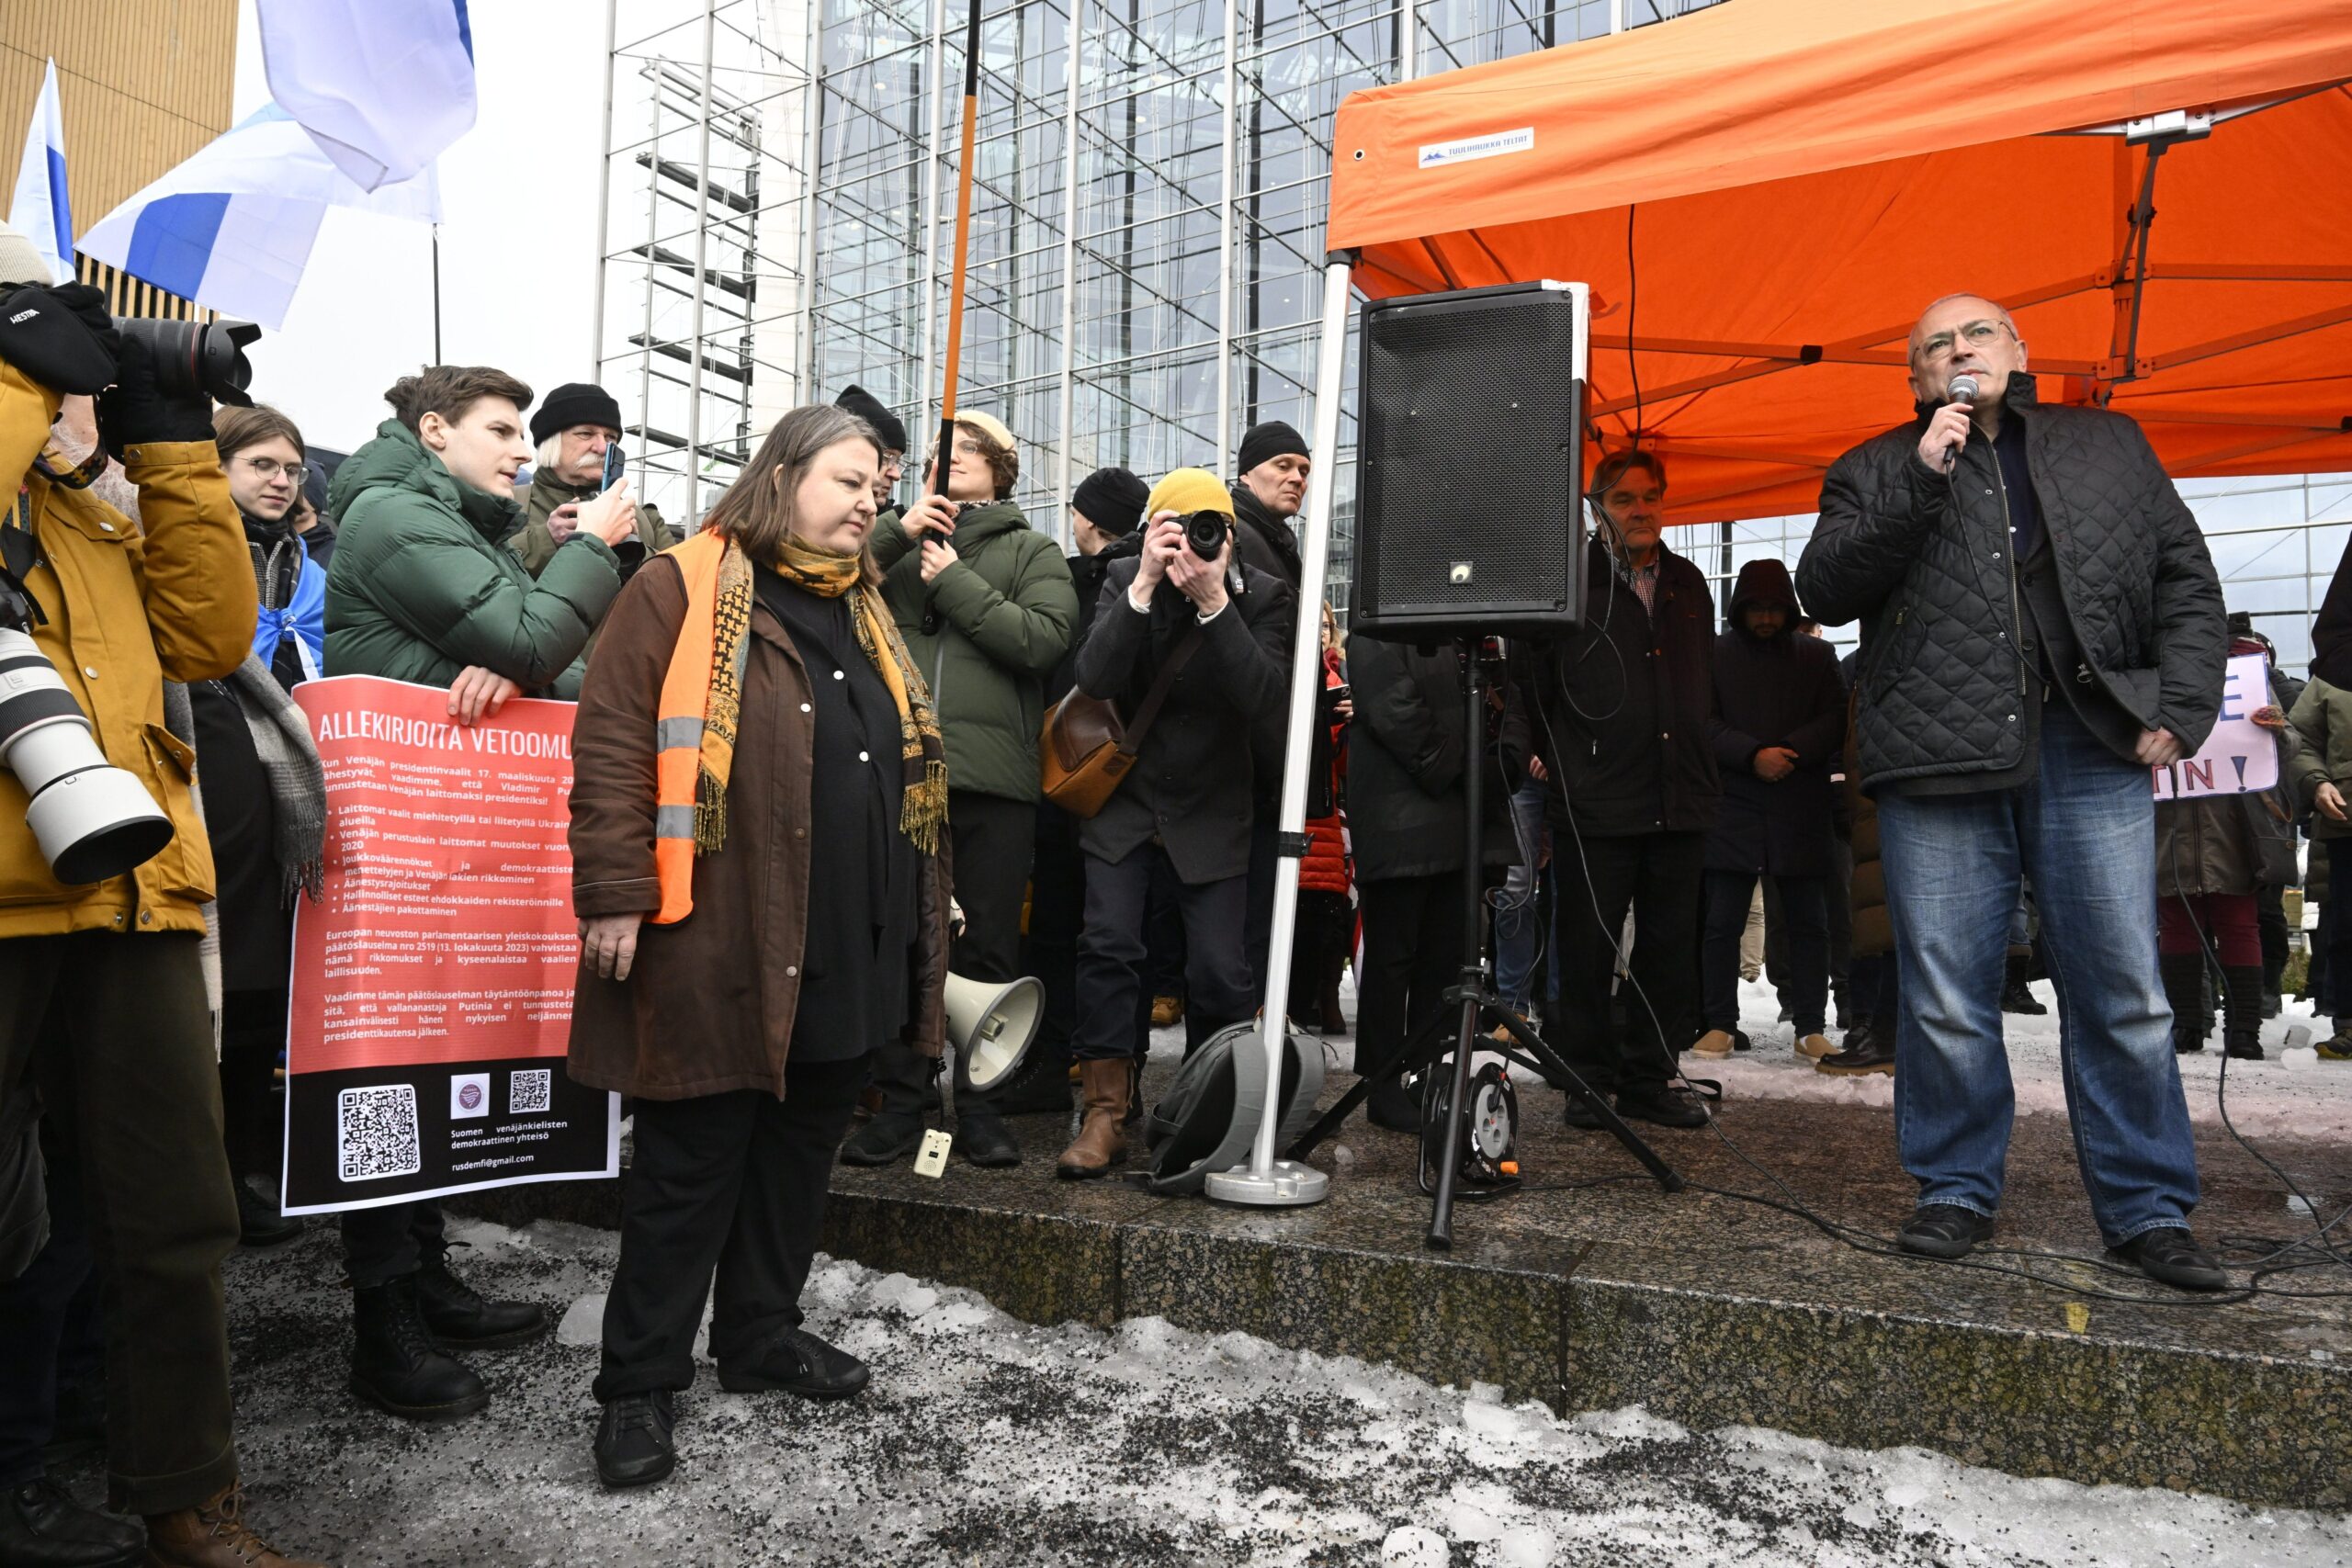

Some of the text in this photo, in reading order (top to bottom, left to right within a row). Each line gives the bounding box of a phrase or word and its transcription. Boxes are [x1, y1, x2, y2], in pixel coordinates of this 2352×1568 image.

[319, 710, 572, 760] ALLEKIRJOITA VETOOMU
[345, 756, 385, 768] Venäjän
[390, 761, 471, 777] presidentinvaalit
[478, 770, 492, 778] 17.
[498, 772, 555, 784] maaliskuuta
[390, 784, 423, 797] Venäjän
[426, 787, 482, 801] laittomaksi
[485, 793, 548, 806] presidentiksi!
[462, 781, 482, 789] että
[501, 783, 540, 794] Vladimir
[339, 805, 386, 815] Laittomat
[389, 808, 410, 818] vaalit
[413, 811, 475, 825] miehitetyillä
[479, 816, 492, 824] tai
[494, 816, 536, 828] liitetyillä
[339, 816, 376, 827] alueilla
[340, 828, 379, 840] Venäjän
[382, 832, 435, 845] perustuslain
[439, 837, 486, 848] laittomat
[491, 840, 540, 851] muutokset
[342, 840, 364, 852] 2020
[343, 852, 433, 868] Joukkoväärennökset
[461, 861, 470, 872] ja
[345, 866, 535, 884] menettelyjen ja Venäjän lakien rikkominen
[344, 878, 430, 890] Äänestysrajoitukset
[343, 889, 563, 907] Hallinnolliset esteet ehdokkaiden rekisteröinnille
[342, 902, 457, 917] Äänestäjien pakottaminen
[326, 929, 577, 942] Euroopan neuvoston parlamentaarisen yleiskokouksen
[325, 940, 577, 955] päätöslauselma nro 2519 (13. lokakuuta 2023) vahvistaa
[324, 953, 576, 965] nämä rikkomukset ja kyseenalaistaa vaalien
[324, 989, 575, 1003] Vaadimme tämän päätöslauselman täytäntöönpanoa ja
[359, 1003, 378, 1012] että
[387, 1003, 447, 1014] vallananastaja
[459, 1002, 492, 1010] Putinia
[503, 1002, 512, 1010] ei
[323, 1015, 399, 1029] kansainvälisesti
[418, 1015, 443, 1024] hänen
[466, 1013, 507, 1025] nykyisen
[323, 1028, 449, 1044] presidenttikautensa jälkeen.
[451, 1120, 568, 1138] Suomen venäjänkielisten
[451, 1132, 549, 1149] demokraattinen yhteisö
[452, 1154, 534, 1171] rusdemfi@gmail.com
